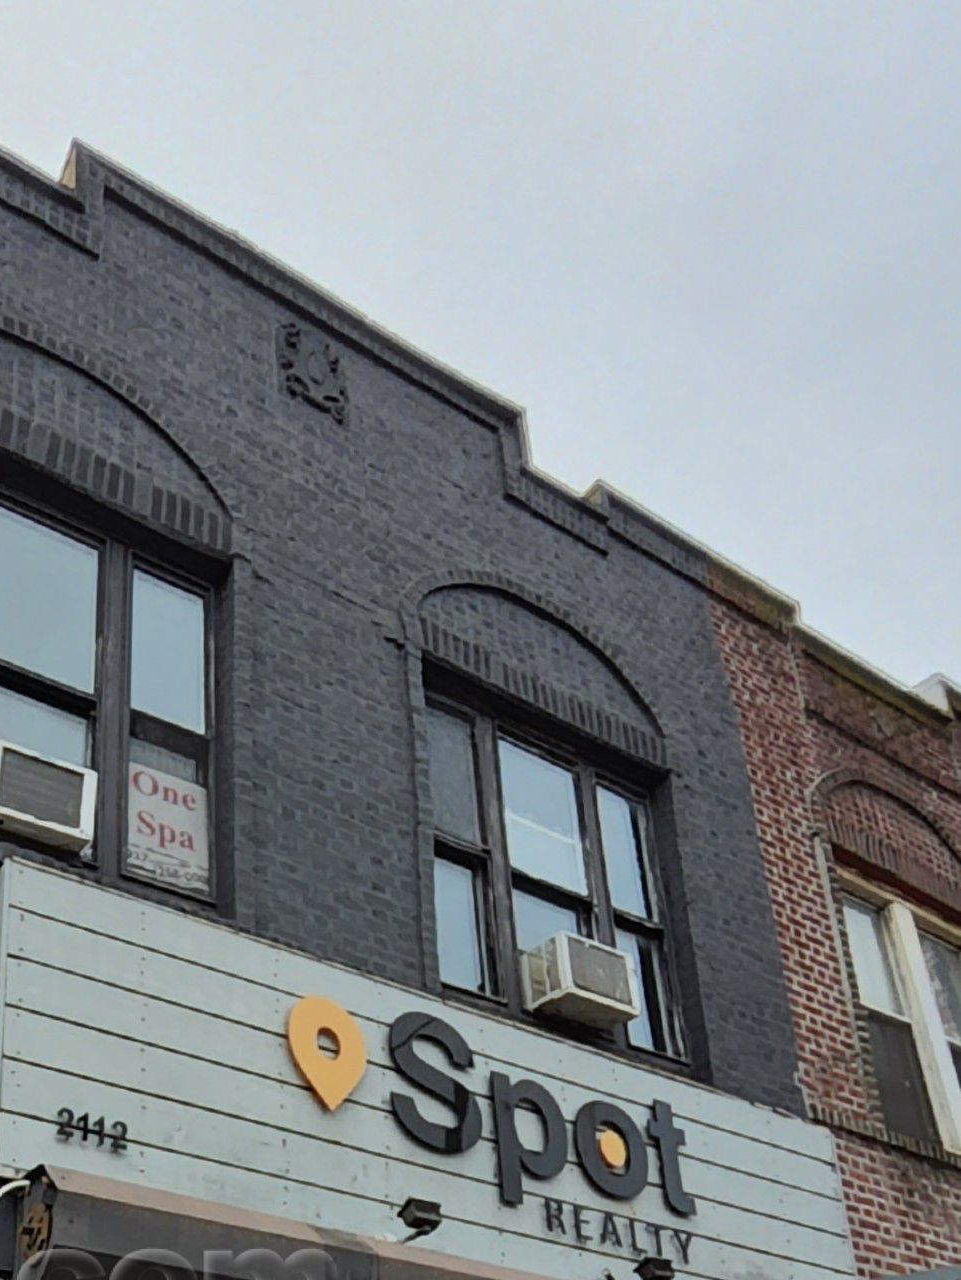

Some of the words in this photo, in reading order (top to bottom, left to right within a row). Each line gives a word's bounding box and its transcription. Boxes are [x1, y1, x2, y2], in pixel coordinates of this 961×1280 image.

[131, 770, 198, 812] One
[136, 808, 195, 851] Spa
[56, 1106, 129, 1152] 2112
[388, 1010, 697, 1217] Spot
[543, 1195, 694, 1266] REALTY
